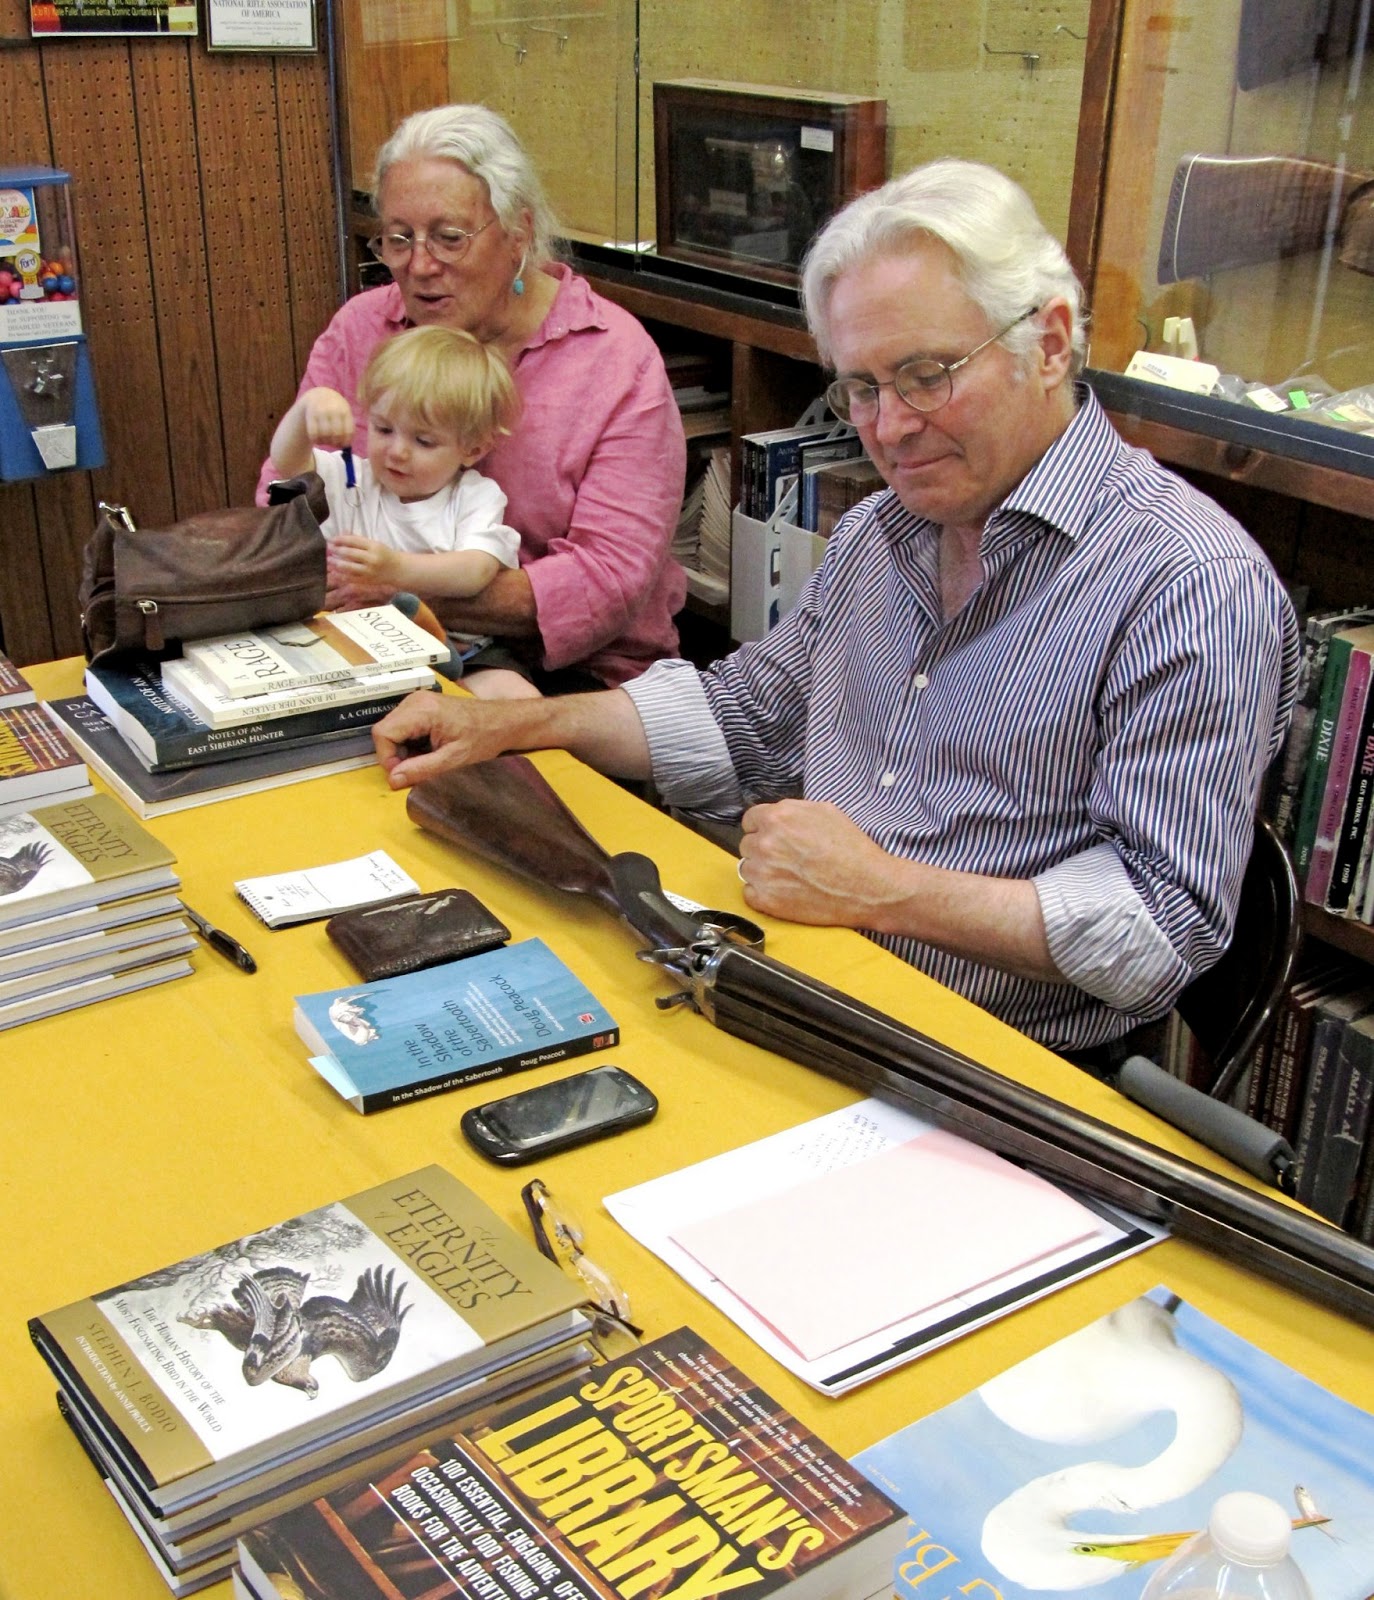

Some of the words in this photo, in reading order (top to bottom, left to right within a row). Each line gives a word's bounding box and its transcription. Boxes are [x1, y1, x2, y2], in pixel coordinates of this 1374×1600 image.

[252, 10, 280, 18] AMERICA
[359, 611, 425, 655] FALCONS
[224, 639, 288, 678] RAGE
[268, 678, 296, 692] RAGE
[309, 670, 352, 683] FALCONS
[148, 696, 176, 714] NOTES
[188, 745, 208, 756] EAST
[210, 738, 247, 751] SIBERIAN
[250, 730, 284, 744] HUNTER
[208, 730, 236, 742] NOTES
[238, 728, 249, 736] OF
[250, 724, 263, 734] AN
[1316, 719, 1334, 762] DIXIE
[1361, 735, 1374, 776] DIXIE
[1360, 780, 1368, 795] GUN
[51, 821, 107, 863] EAGLES
[64, 804, 138, 860] ETERNITY
[488, 974, 526, 1012] Peacock
[414, 1023, 453, 1063] Shadow
[442, 1000, 493, 1052] Sabertooth
[523, 1009, 552, 1038] Doug
[404, 1039, 424, 1058] the
[415, 1056, 432, 1069] In
[392, 1094, 400, 1102] In
[401, 1090, 413, 1099] the
[414, 1084, 442, 1096] Shadow
[443, 1080, 452, 1088] of
[452, 1077, 464, 1086] the
[465, 1067, 503, 1082] Sabertooth
[520, 1058, 538, 1068] Doug
[539, 1050, 566, 1062] Peacock
[385, 1222, 491, 1309] EAGLES
[392, 1188, 532, 1300] ETERNITY
[75, 1335, 116, 1387] INTRODUCTION
[88, 1322, 134, 1379] STEPHEN
[127, 1380, 142, 1392] J.
[139, 1393, 177, 1433] BODIO
[176, 1349, 205, 1382] HISTORY
[209, 1389, 225, 1406] THE
[161, 1360, 181, 1383] BIRD
[183, 1388, 200, 1404] THE
[197, 1402, 223, 1433] WORLD
[580, 1365, 825, 1570] SPORTSMAN'S
[475, 1395, 765, 1600] LIBRARY
[847, 1484, 862, 1498] have
[390, 1484, 432, 1519] BOOKS
[420, 1516, 450, 1541] FOR
[438, 1535, 469, 1562] THE
[410, 1466, 485, 1536] OCCASIONALLY
[471, 1533, 504, 1560] ODD
[491, 1554, 540, 1600] FISHING
[439, 1458, 467, 1480] 100
[455, 1475, 512, 1533] ESSENTIAL,
[504, 1528, 561, 1586] ENGAGING,
